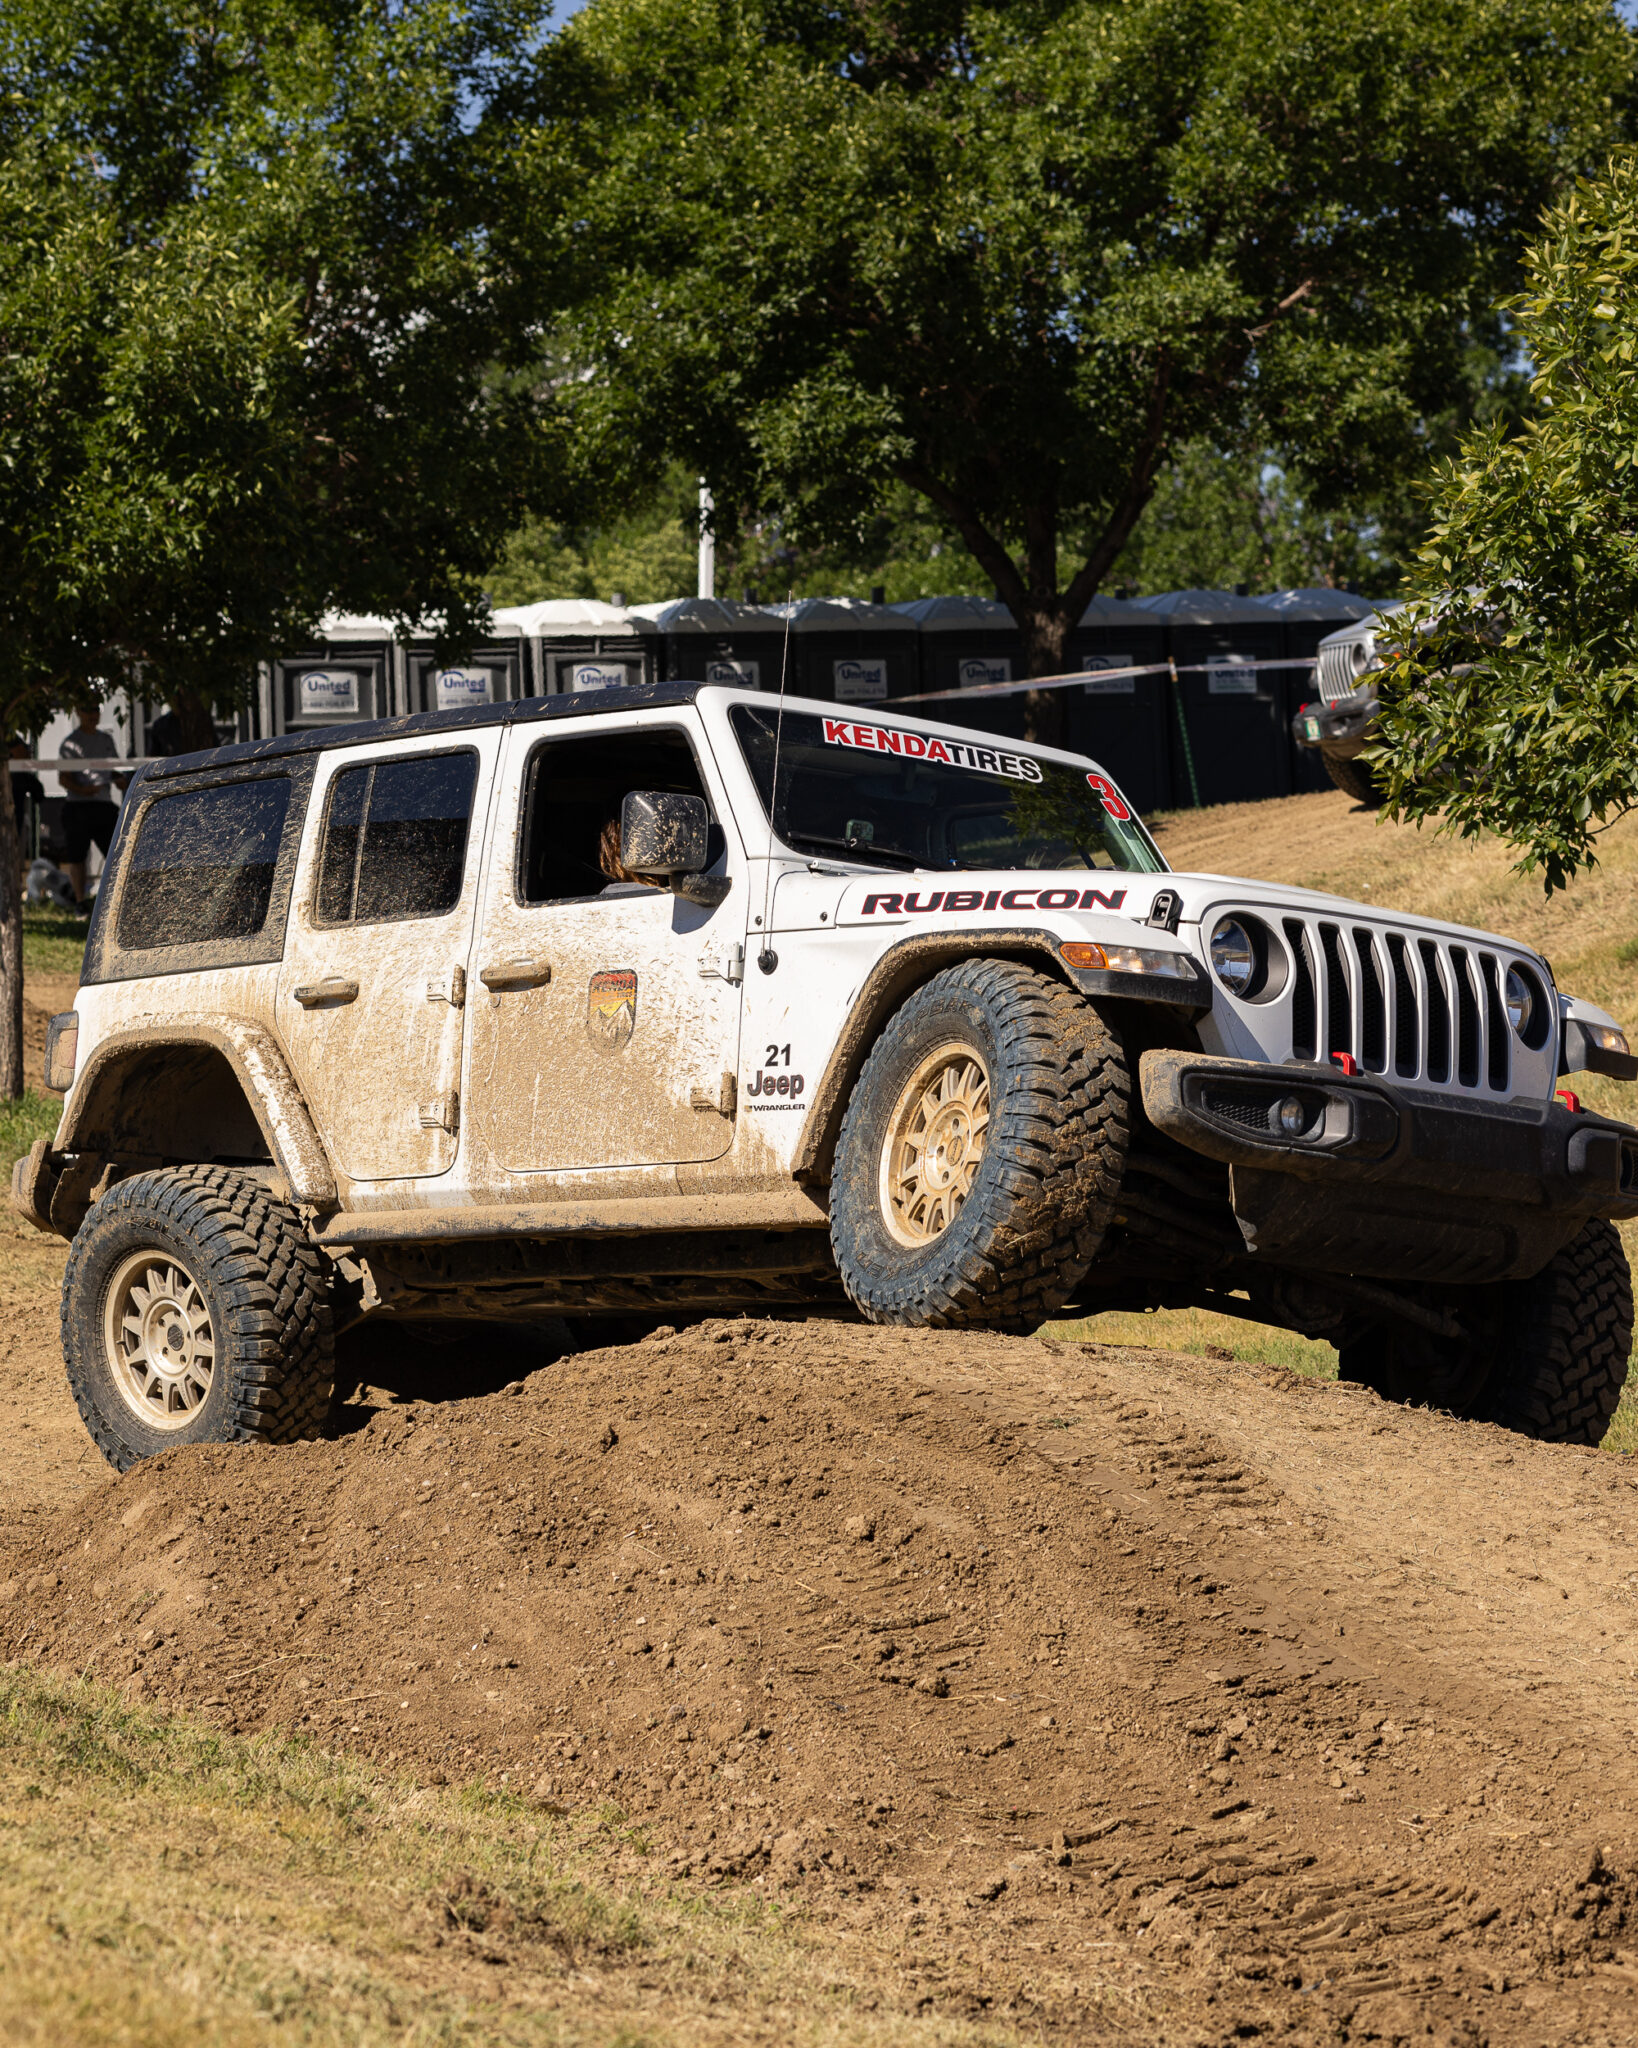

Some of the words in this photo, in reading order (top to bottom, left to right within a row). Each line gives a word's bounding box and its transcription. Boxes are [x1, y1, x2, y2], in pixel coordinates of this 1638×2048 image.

[581, 674, 621, 684] United
[841, 667, 880, 679] United
[308, 680, 350, 692] United
[444, 677, 485, 688] United
[1087, 774, 1130, 820] 3
[861, 889, 1128, 914] RUBICON
[765, 1043, 791, 1067] 21
[747, 1070, 804, 1099] Jeep
[753, 1103, 806, 1112] WRANGLER
